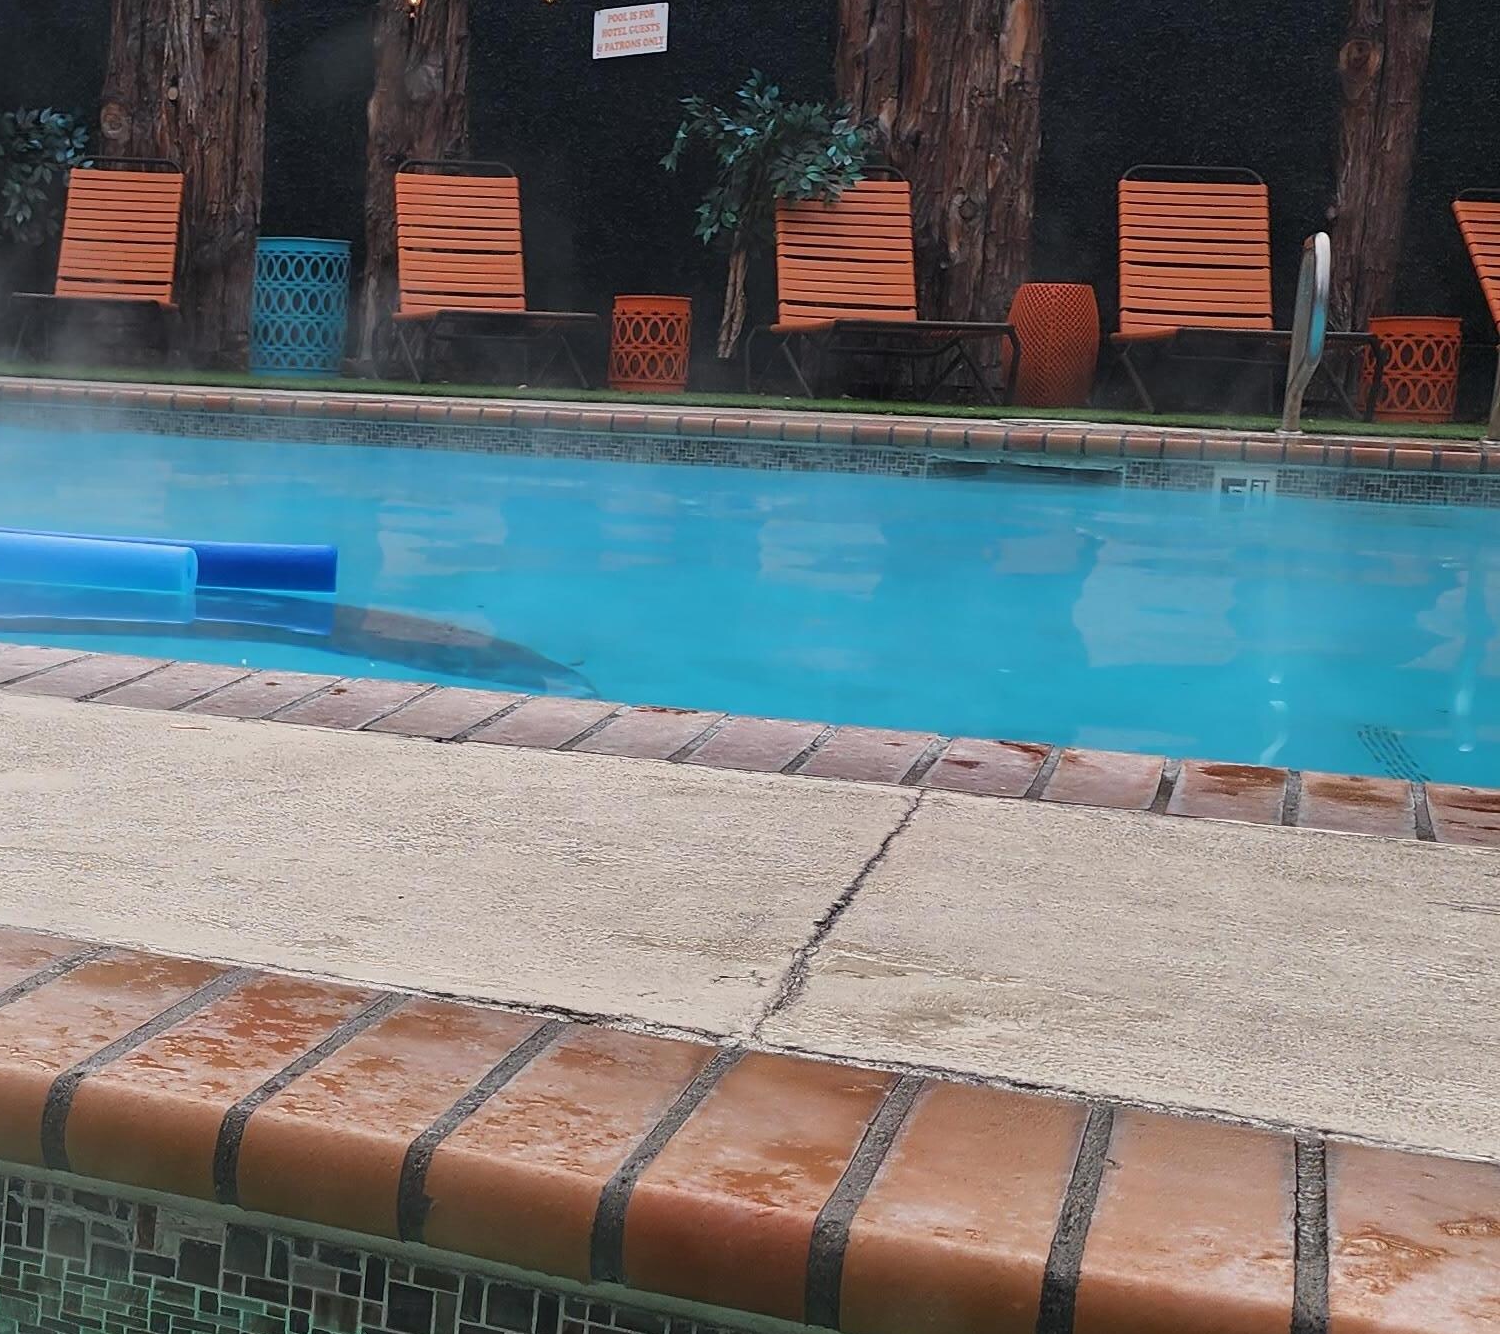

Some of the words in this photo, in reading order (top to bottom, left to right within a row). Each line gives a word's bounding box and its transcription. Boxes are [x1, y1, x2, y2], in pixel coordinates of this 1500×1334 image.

[607, 12, 629, 23] POOL
[629, 11, 638, 20] IS
[639, 9, 655, 19] FOR
[602, 27, 628, 38] HOTEL
[629, 23, 660, 34] GUESTS
[604, 39, 642, 51] PATRONS
[643, 36, 664, 46] ONLY
[1250, 479, 1271, 492] FT
